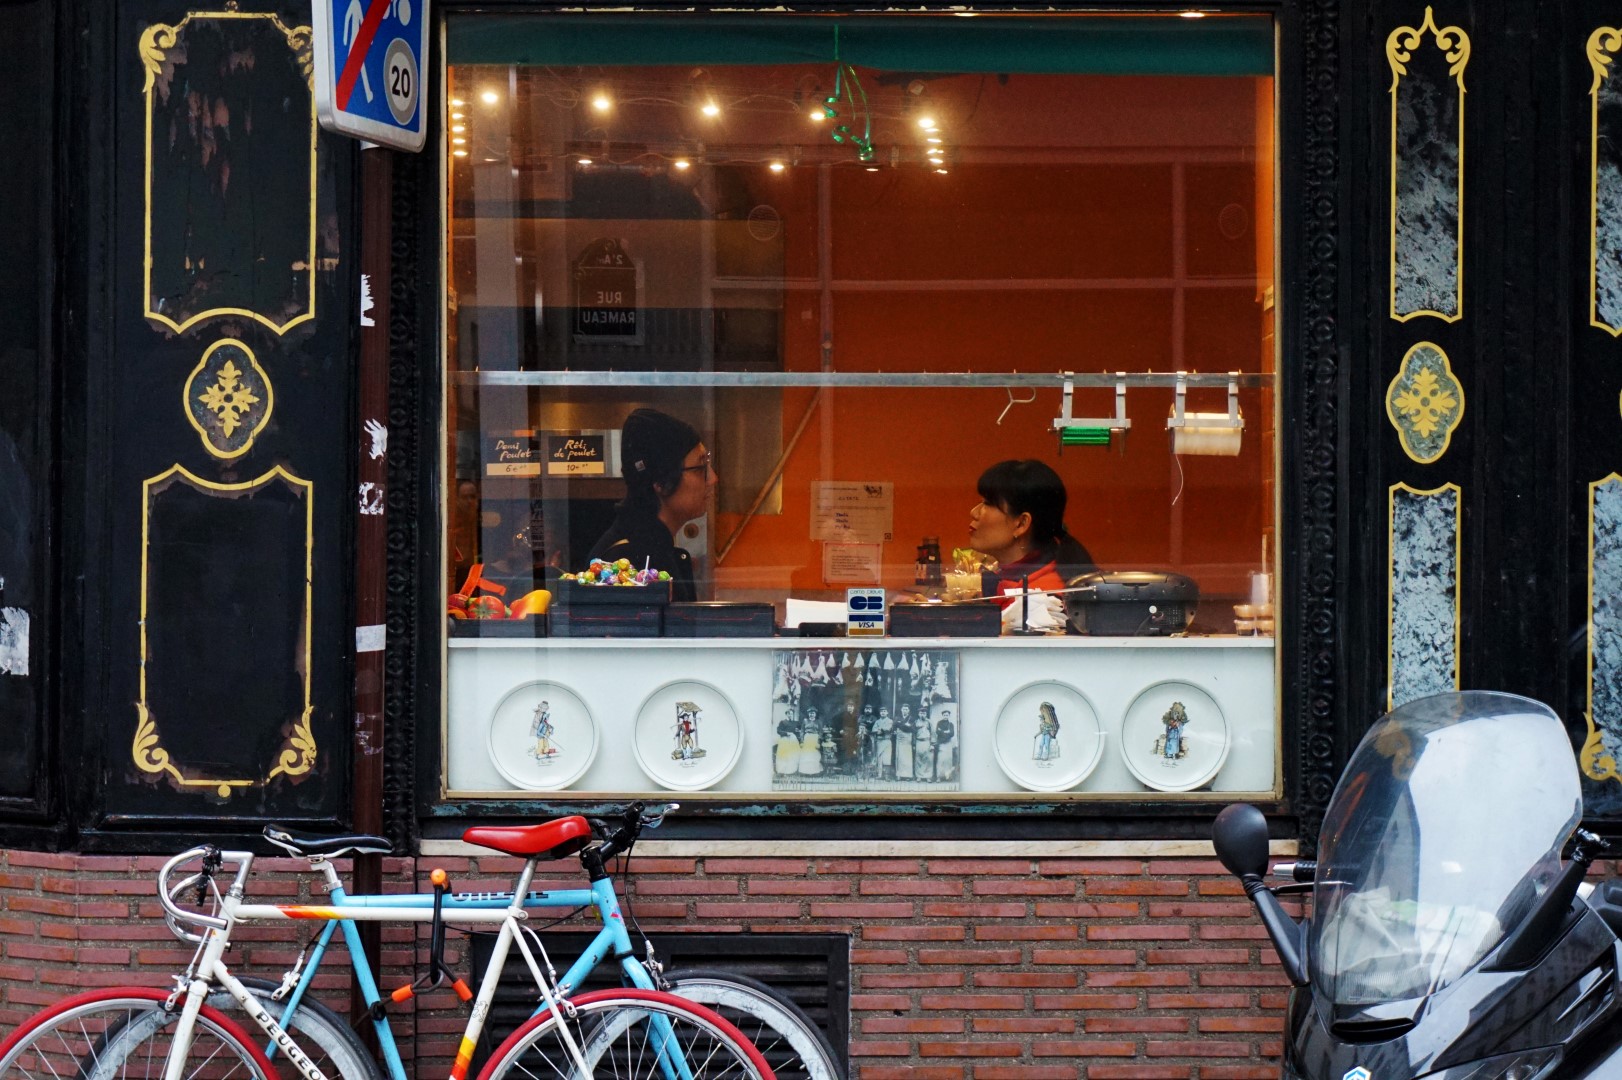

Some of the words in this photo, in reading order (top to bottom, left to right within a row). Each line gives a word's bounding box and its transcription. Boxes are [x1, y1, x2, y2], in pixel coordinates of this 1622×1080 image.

[391, 65, 410, 98] 20
[495, 440, 519, 450] Demi
[850, 596, 883, 610] CB
